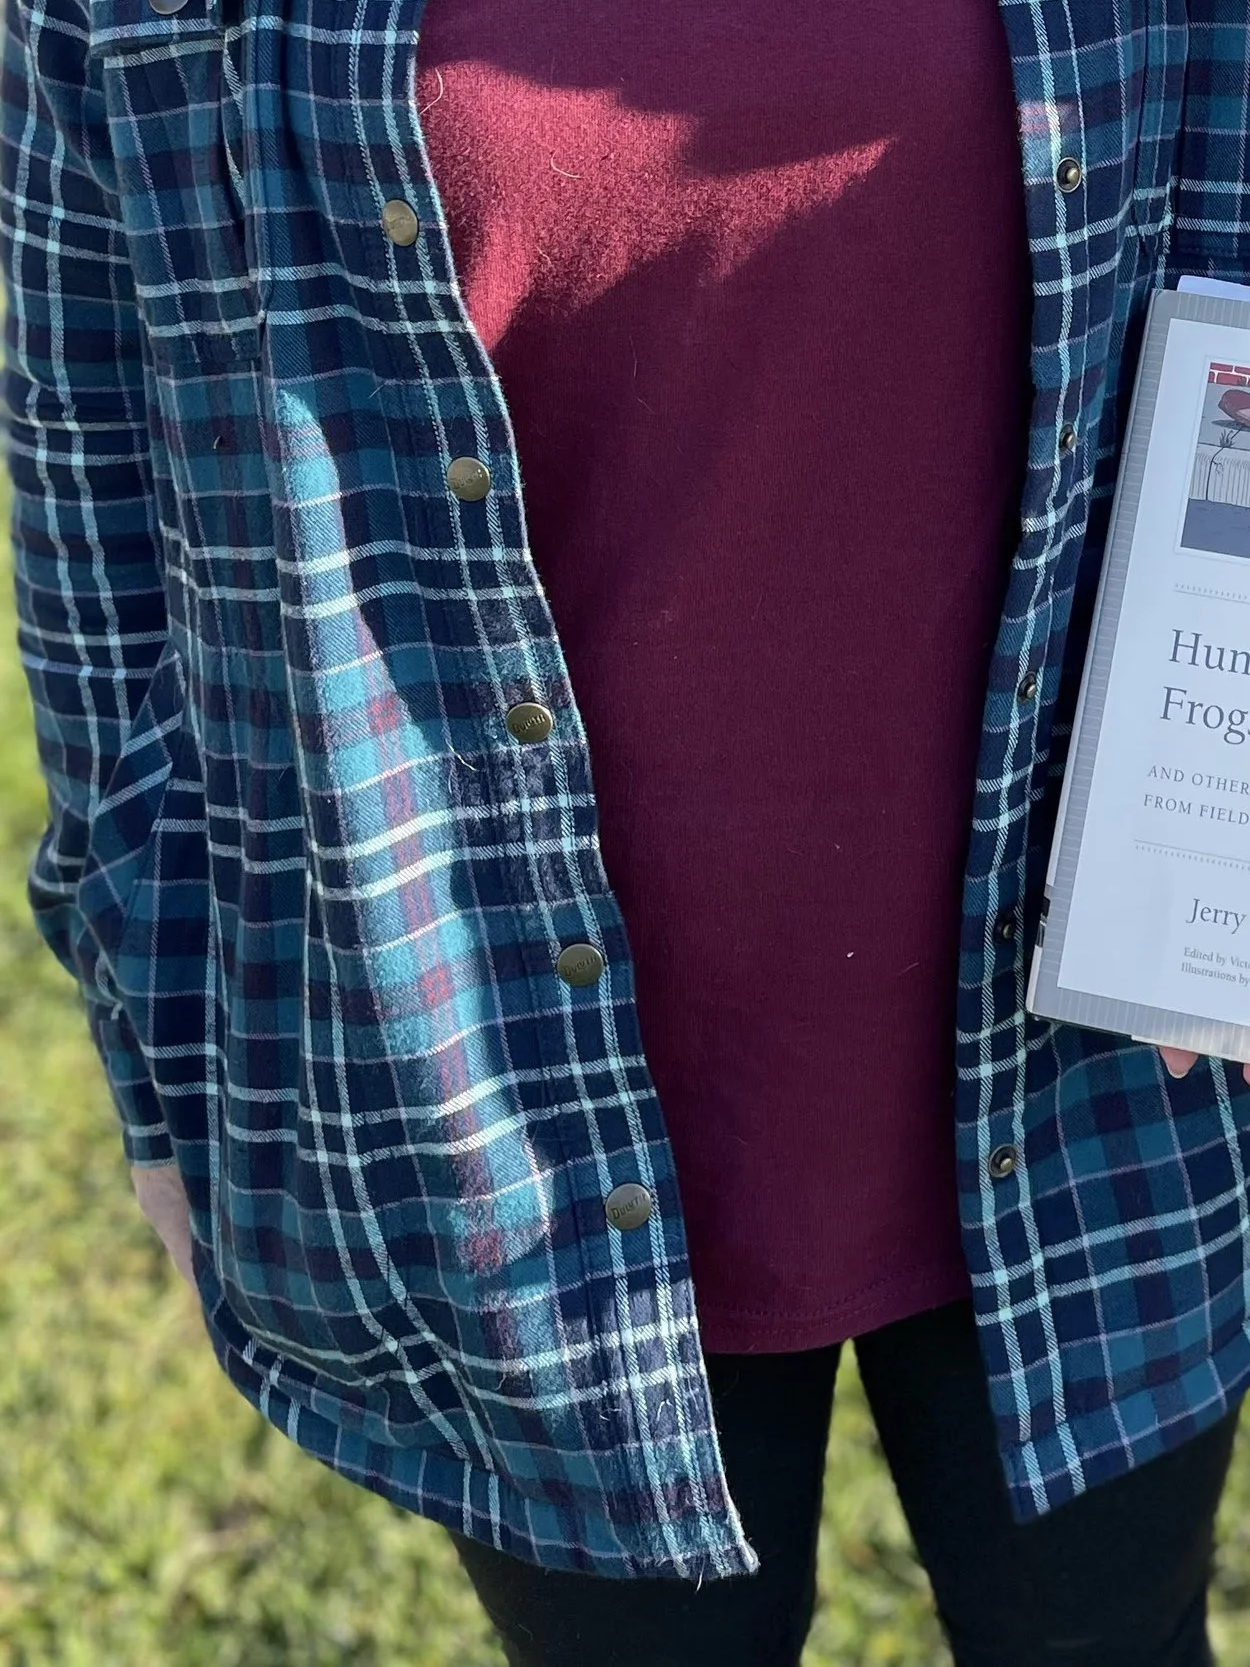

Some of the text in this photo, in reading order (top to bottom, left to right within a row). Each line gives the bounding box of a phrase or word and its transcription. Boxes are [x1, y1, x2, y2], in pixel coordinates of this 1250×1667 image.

[1147, 765, 1185, 783] AND
[1191, 773, 1250, 796] OTHER
[1143, 793, 1192, 815] FROM
[1199, 804, 1250, 825] FIELD
[1185, 898, 1247, 935] Jerry
[1183, 946, 1214, 962] Edited
[1216, 952, 1227, 967] by
[1181, 962, 1237, 983] Illustrations
[1239, 973, 1250, 987] by
